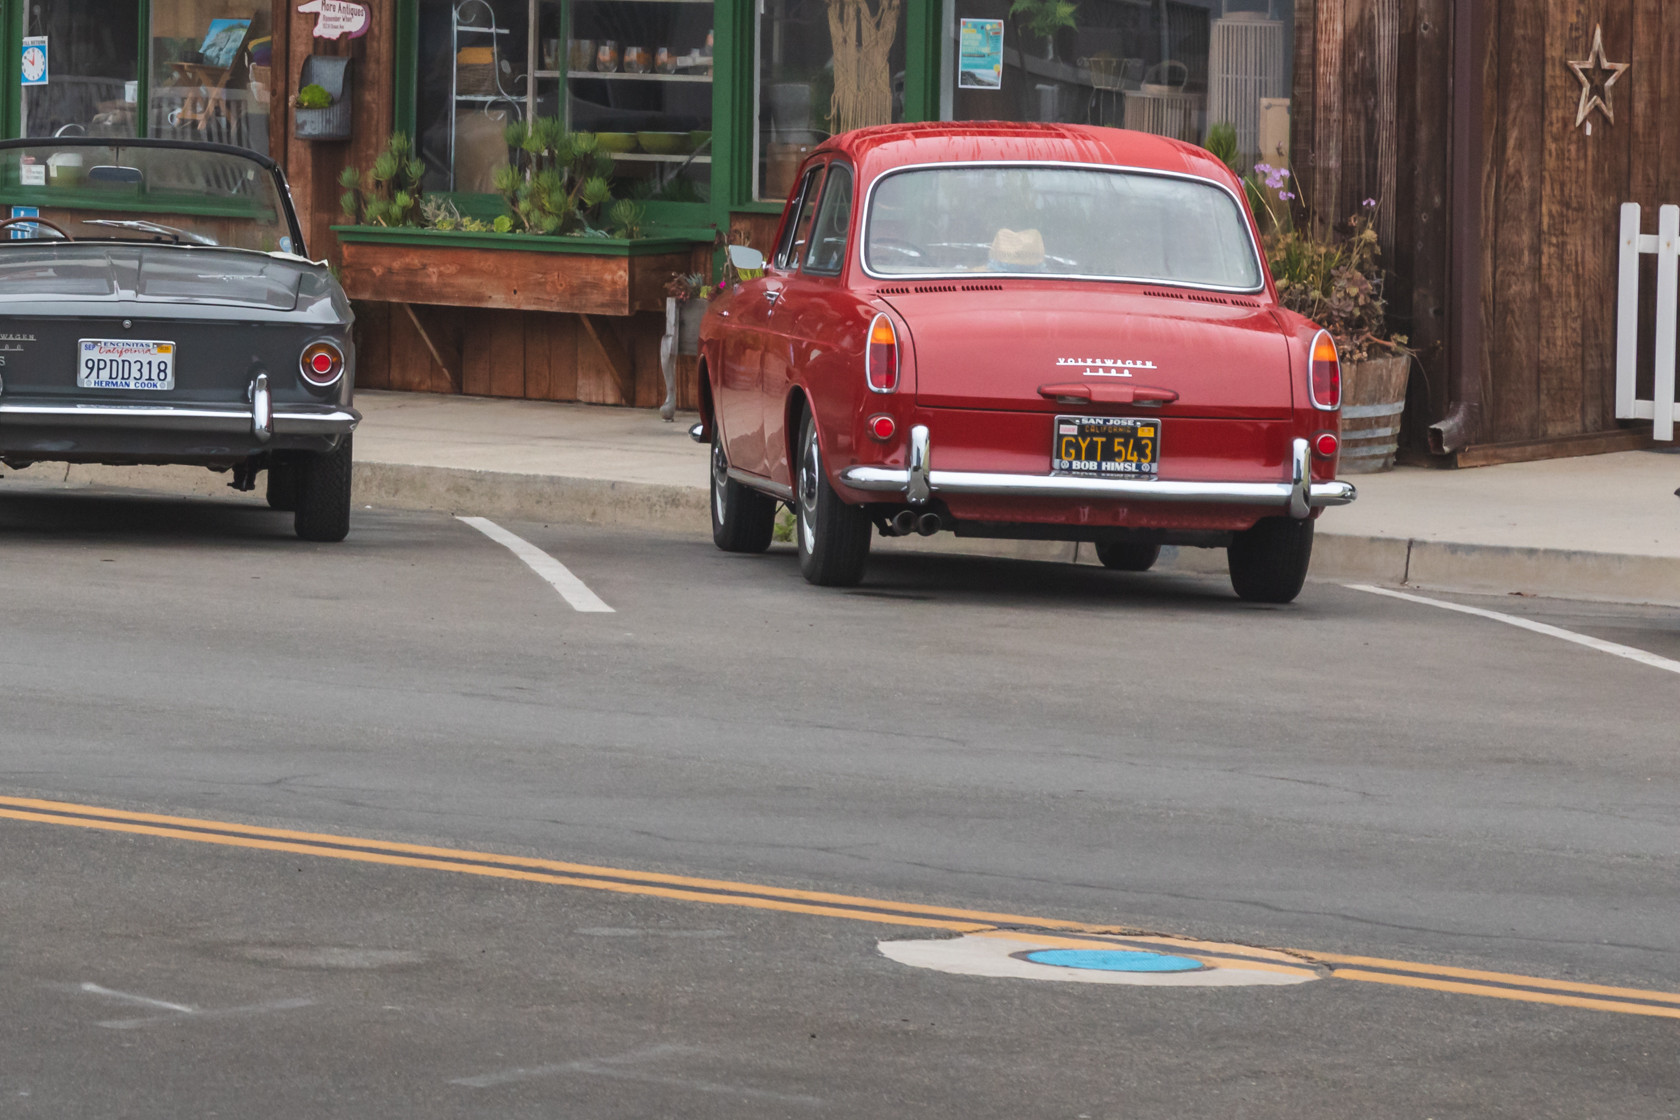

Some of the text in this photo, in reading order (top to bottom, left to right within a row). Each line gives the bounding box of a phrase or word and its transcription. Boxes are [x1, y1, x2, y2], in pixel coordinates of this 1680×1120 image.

[337, 2, 364, 18] Antiques
[84, 343, 96, 351] SEP
[98, 346, 157, 358] California
[1057, 358, 1153, 368] VOLKSWAGEN
[84, 359, 168, 382] 9PDD318
[93, 380, 158, 389] HERMAN COOK
[1085, 425, 1131, 433] CALIFORNIA
[1061, 436, 1152, 463] GYT 543
[1072, 461, 1139, 472] BOB HIMSL
